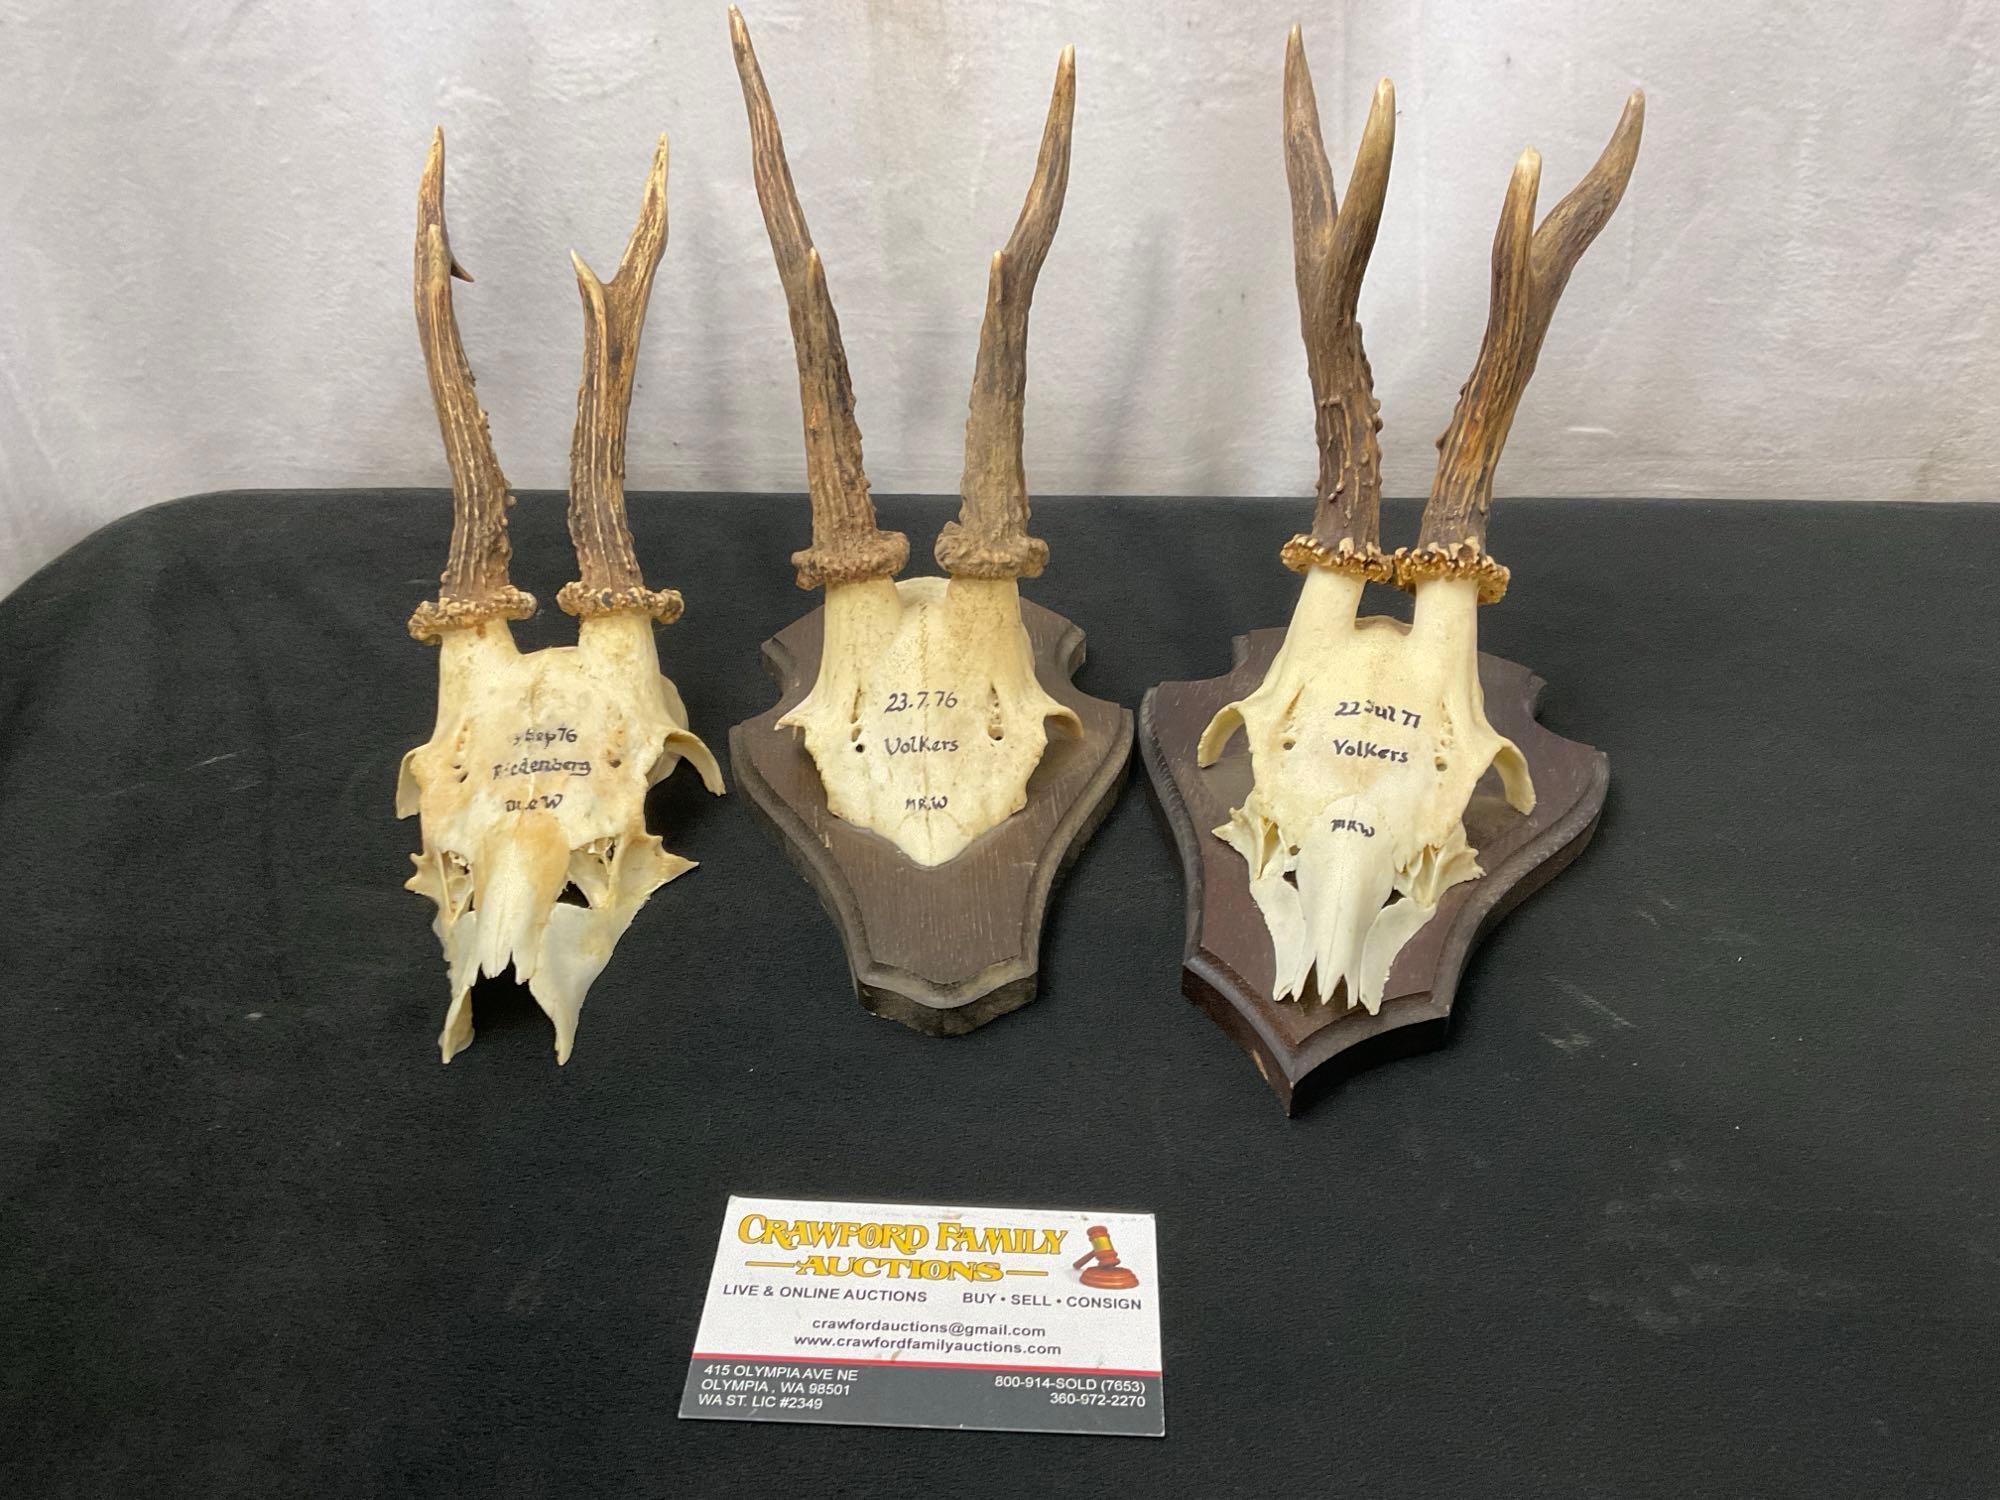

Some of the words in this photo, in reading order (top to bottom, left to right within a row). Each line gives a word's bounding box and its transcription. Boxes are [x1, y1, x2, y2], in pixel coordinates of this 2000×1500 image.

[1335, 702, 1360, 716] 22
[1333, 739, 1409, 763] Volkers
[737, 1214, 928, 1254] CRAWFORD
[937, 1222, 1067, 1256] FAMILY
[794, 1256, 1003, 1282] AUCTIONS
[723, 1284, 759, 1296] LIVE
[764, 1286, 774, 1297] &
[779, 1286, 840, 1300] ONLINE
[844, 1289, 927, 1302] AUCTIONS
[963, 1293, 996, 1304] BUY
[1011, 1294, 1051, 1307] SELL
[1067, 1296, 1142, 1310] CONSIGN
[812, 1319, 1046, 1337] crawfordauctions@gmail.com
[794, 1334, 1061, 1356] www.crawfordfamilyauctions.com
[704, 1365, 730, 1377] 415
[801, 1368, 834, 1381] AVE
[837, 1369, 858, 1381] NE
[781, 1382, 805, 1394] WA
[809, 1383, 850, 1395] 98501
[995, 1376, 1097, 1391] 800-914-SOLD
[1101, 1379, 1145, 1393] (7653)
[698, 1395, 724, 1406] WA
[752, 1396, 776, 1408] LIC
[779, 1397, 822, 1410] #2349
[1050, 1393, 1145, 1408] 360-972-2270
